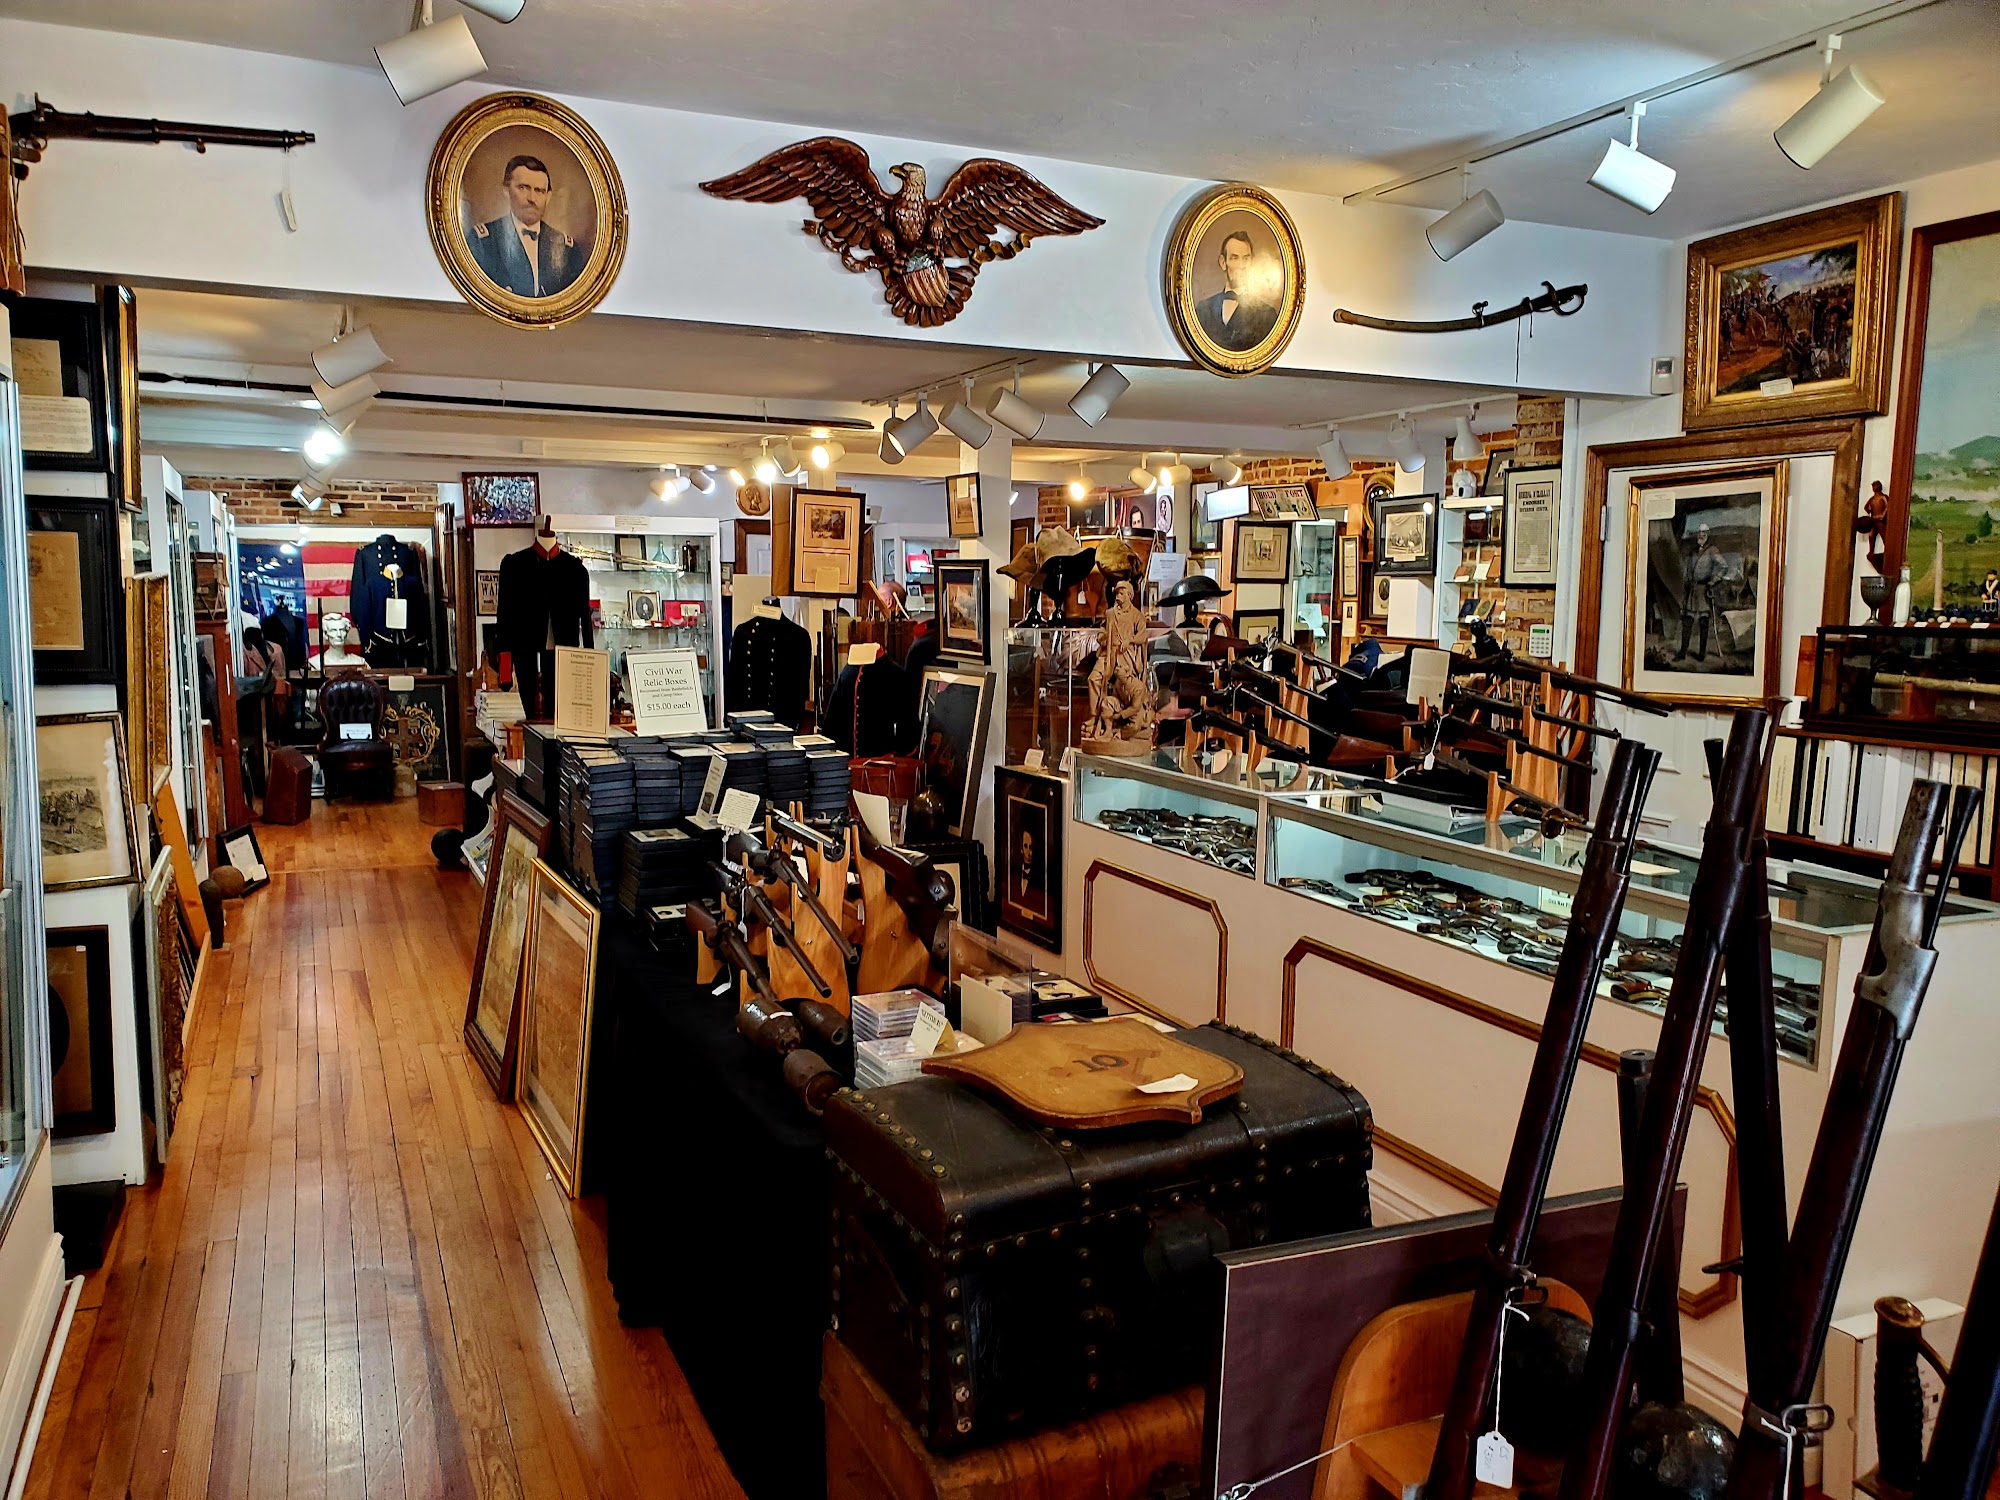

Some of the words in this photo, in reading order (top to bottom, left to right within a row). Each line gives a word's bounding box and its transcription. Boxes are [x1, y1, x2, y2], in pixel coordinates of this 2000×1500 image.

[645, 668, 664, 676] Civil
[665, 667, 683, 675] War
[643, 679, 663, 687] Relic
[665, 678, 687, 686] Boxes
[647, 702, 672, 711] $15.00
[673, 701, 691, 710] each
